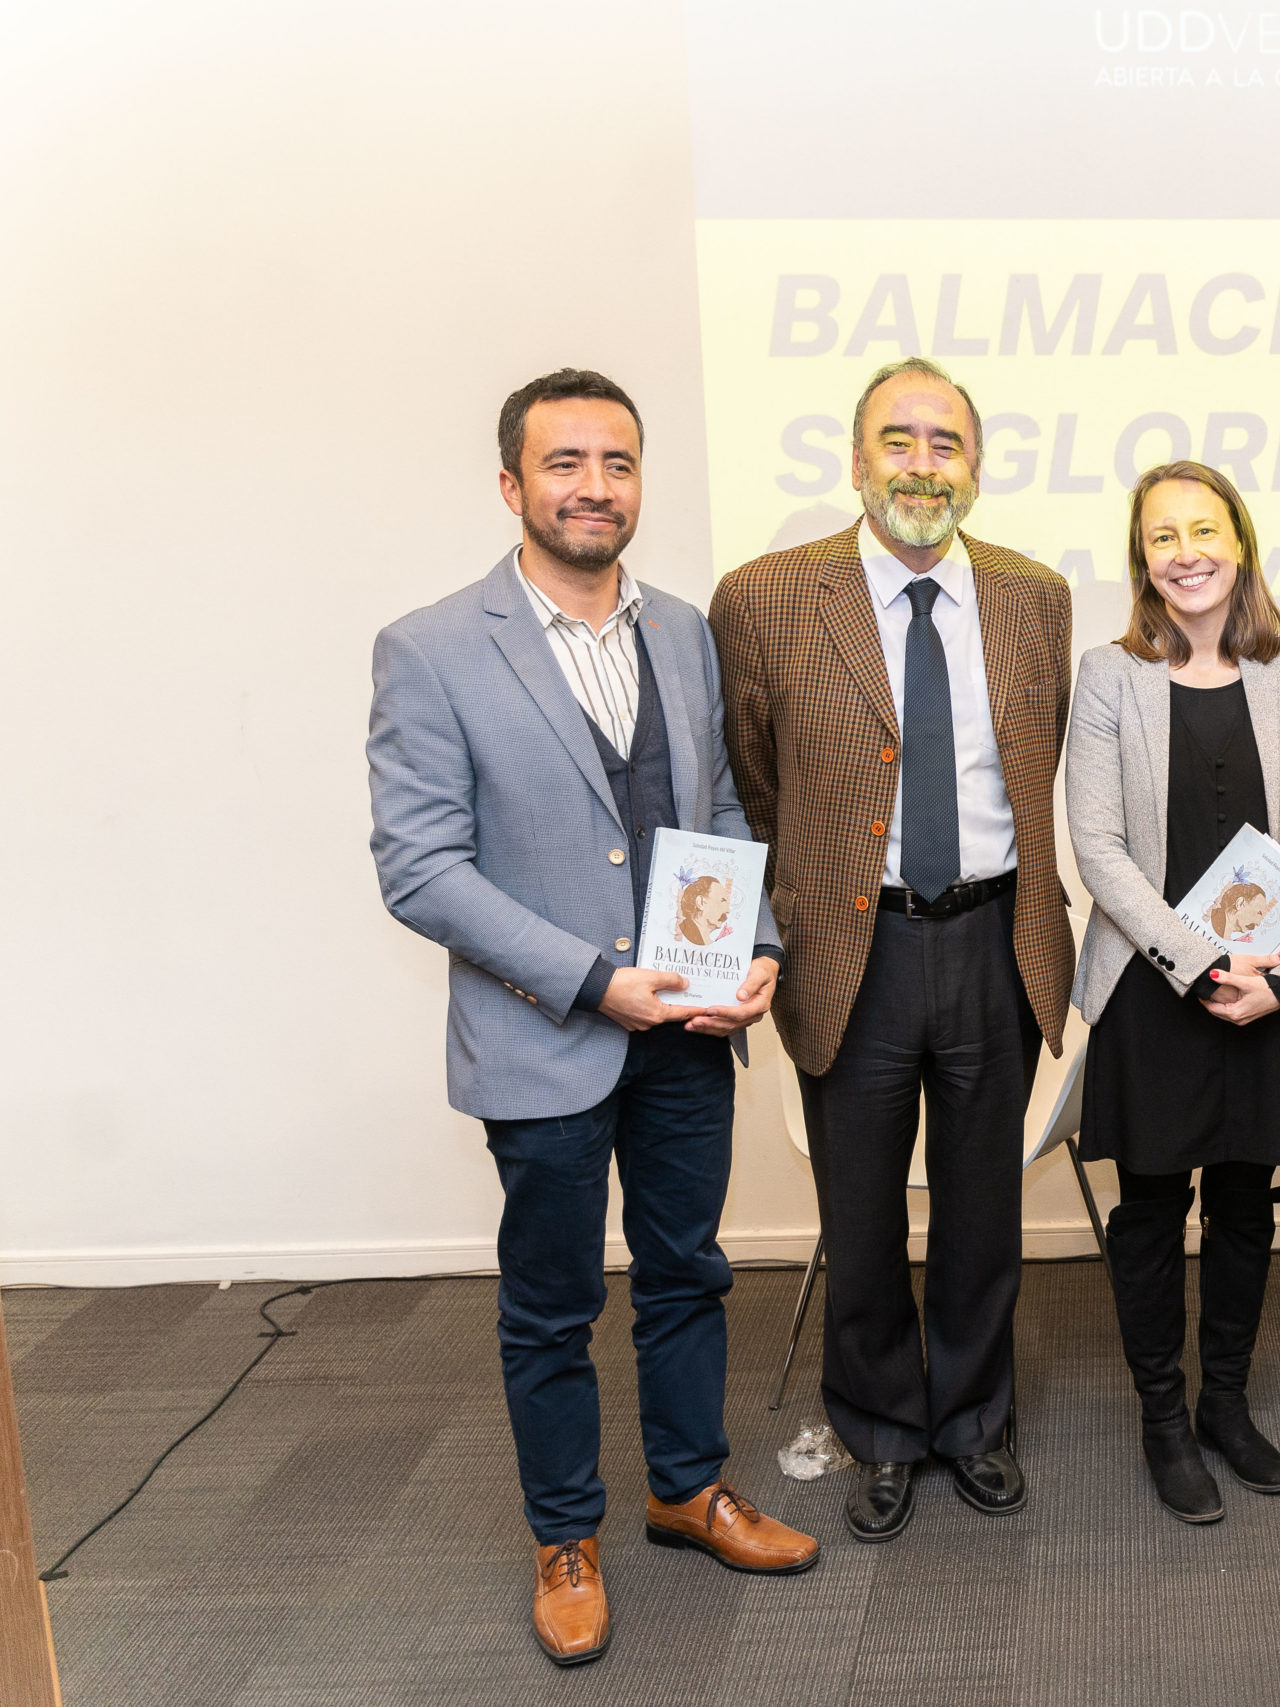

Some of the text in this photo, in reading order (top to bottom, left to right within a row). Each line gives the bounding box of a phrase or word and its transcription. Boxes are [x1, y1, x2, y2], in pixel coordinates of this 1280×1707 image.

[1095, 66, 1195, 88] ABIERTA
[1206, 66, 1223, 88] A
[1234, 67, 1265, 88] LA
[654, 945, 741, 971] BALMACEDA
[704, 968, 713, 978] SU
[716, 970, 740, 981] FALTA
